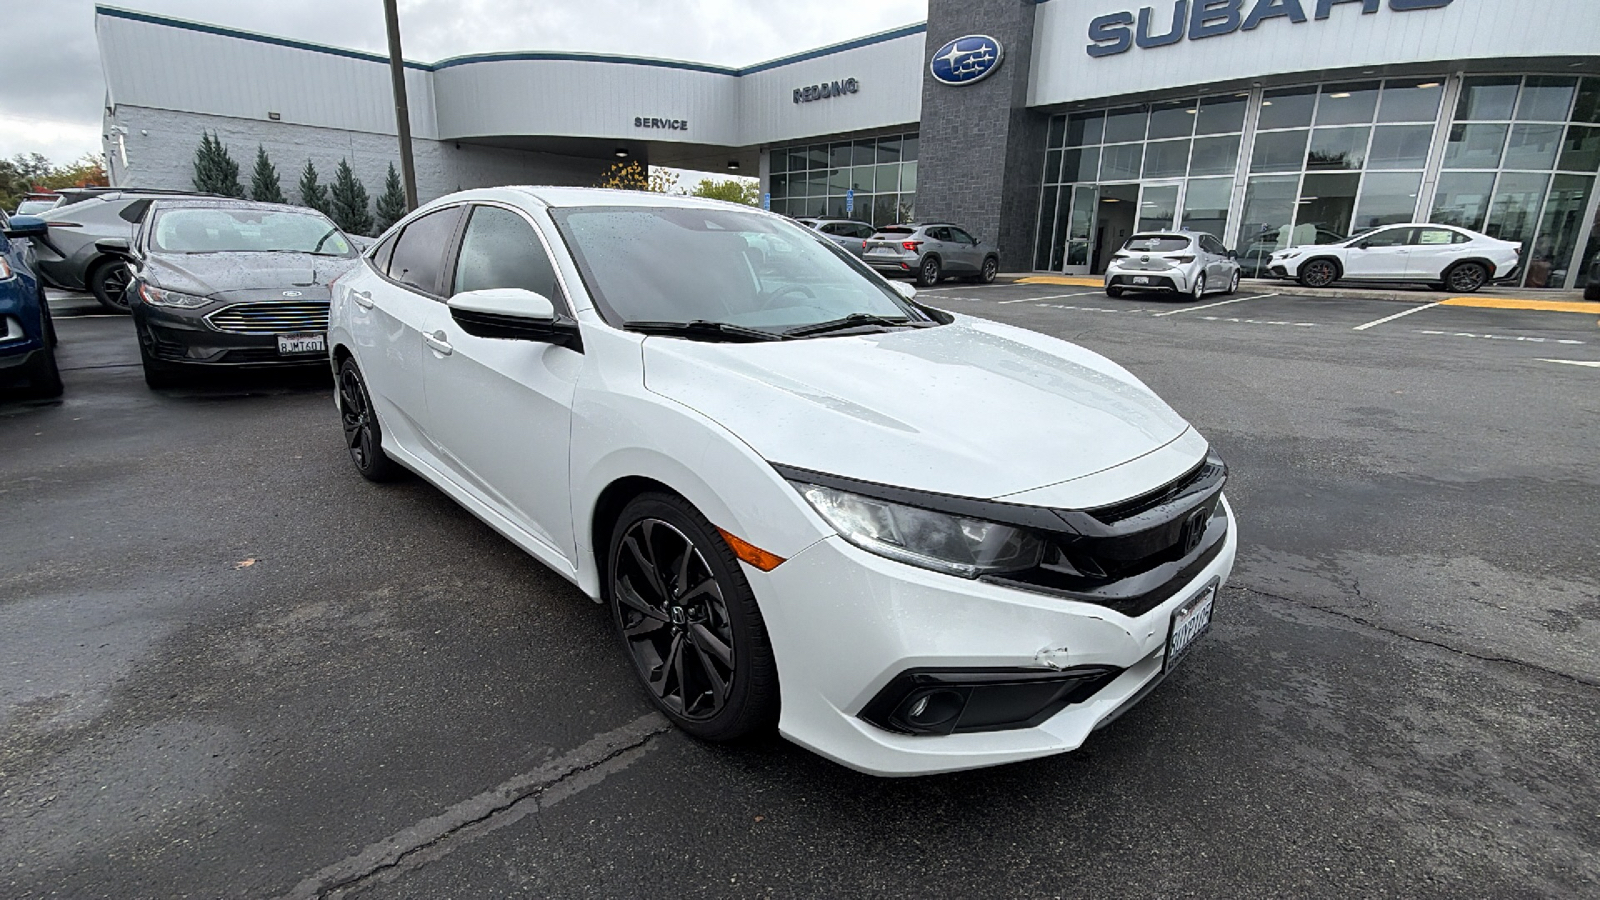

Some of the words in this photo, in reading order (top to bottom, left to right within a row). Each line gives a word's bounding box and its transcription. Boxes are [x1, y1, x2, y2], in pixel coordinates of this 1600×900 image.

[793, 77, 859, 104] REDDING
[634, 117, 688, 130] SERVICE
[281, 341, 323, 352] 8JMT607
